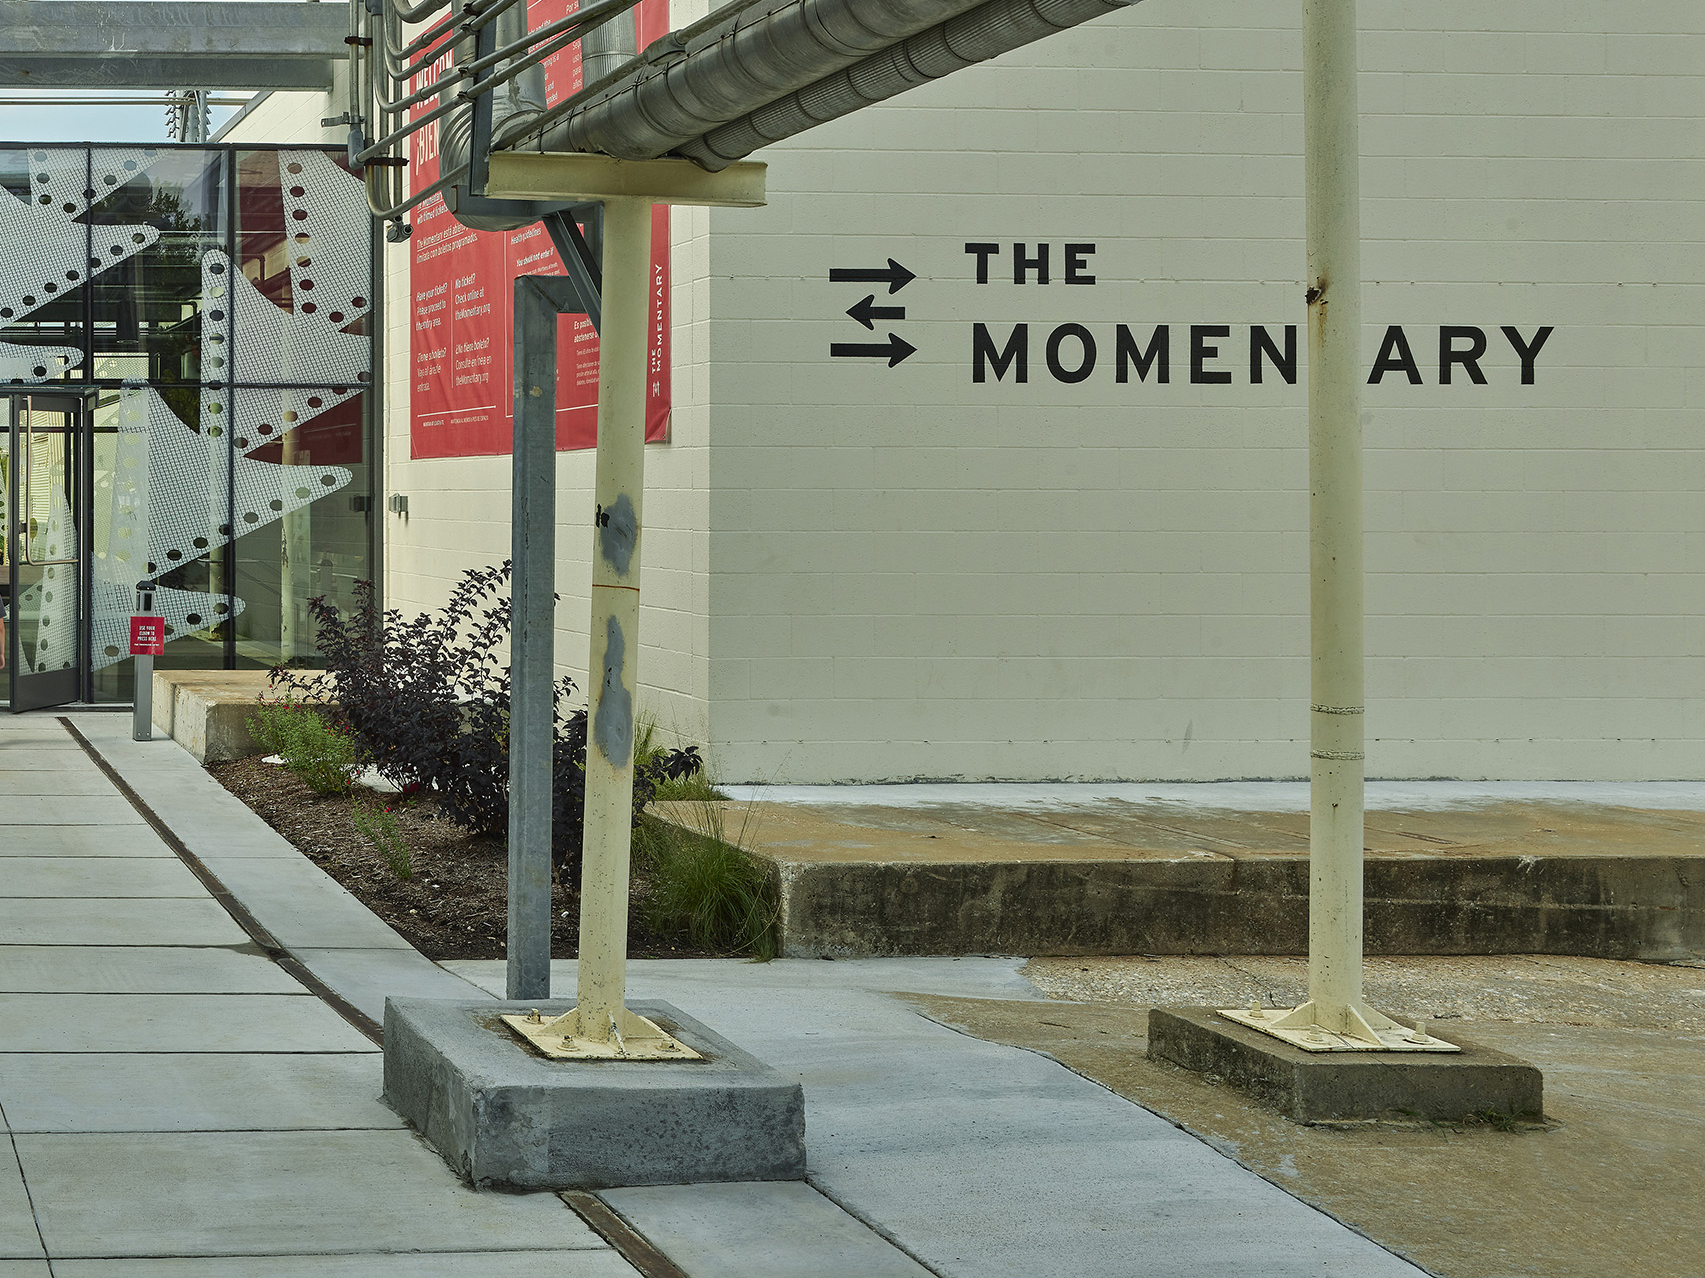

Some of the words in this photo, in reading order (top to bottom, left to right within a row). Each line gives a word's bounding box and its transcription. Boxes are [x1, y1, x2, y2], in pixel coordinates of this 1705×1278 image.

[964, 242, 1096, 285] THE
[654, 263, 663, 372] MOMENTARY
[972, 322, 1555, 386] MOMENARY
